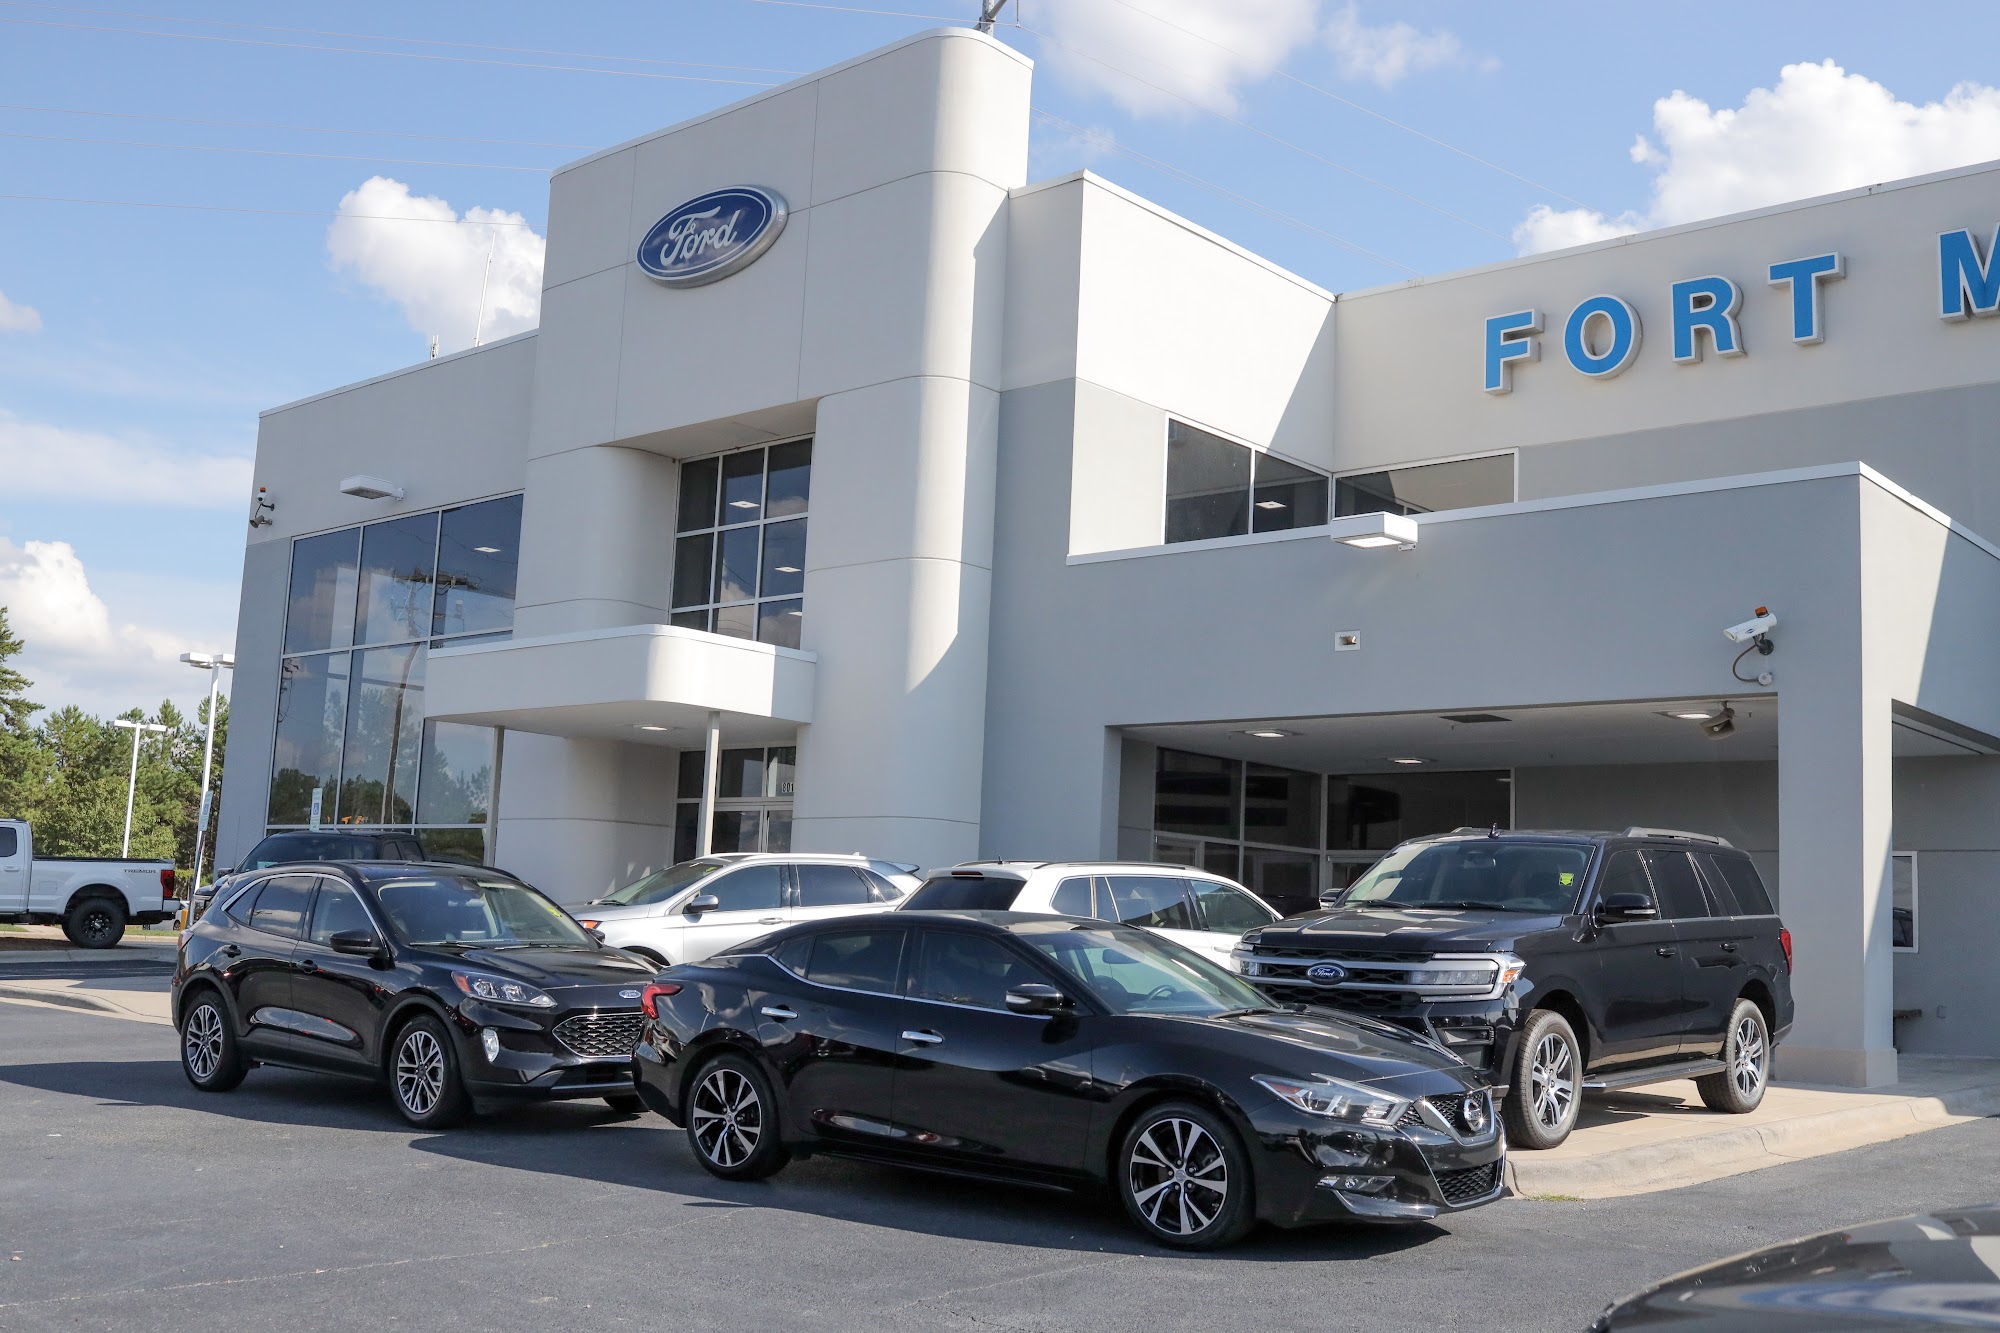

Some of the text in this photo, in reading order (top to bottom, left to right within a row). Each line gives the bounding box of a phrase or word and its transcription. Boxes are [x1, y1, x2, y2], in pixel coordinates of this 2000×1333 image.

[660, 205, 741, 266] Ford
[1484, 252, 1845, 395] FORT
[782, 782, 794, 793] 801
